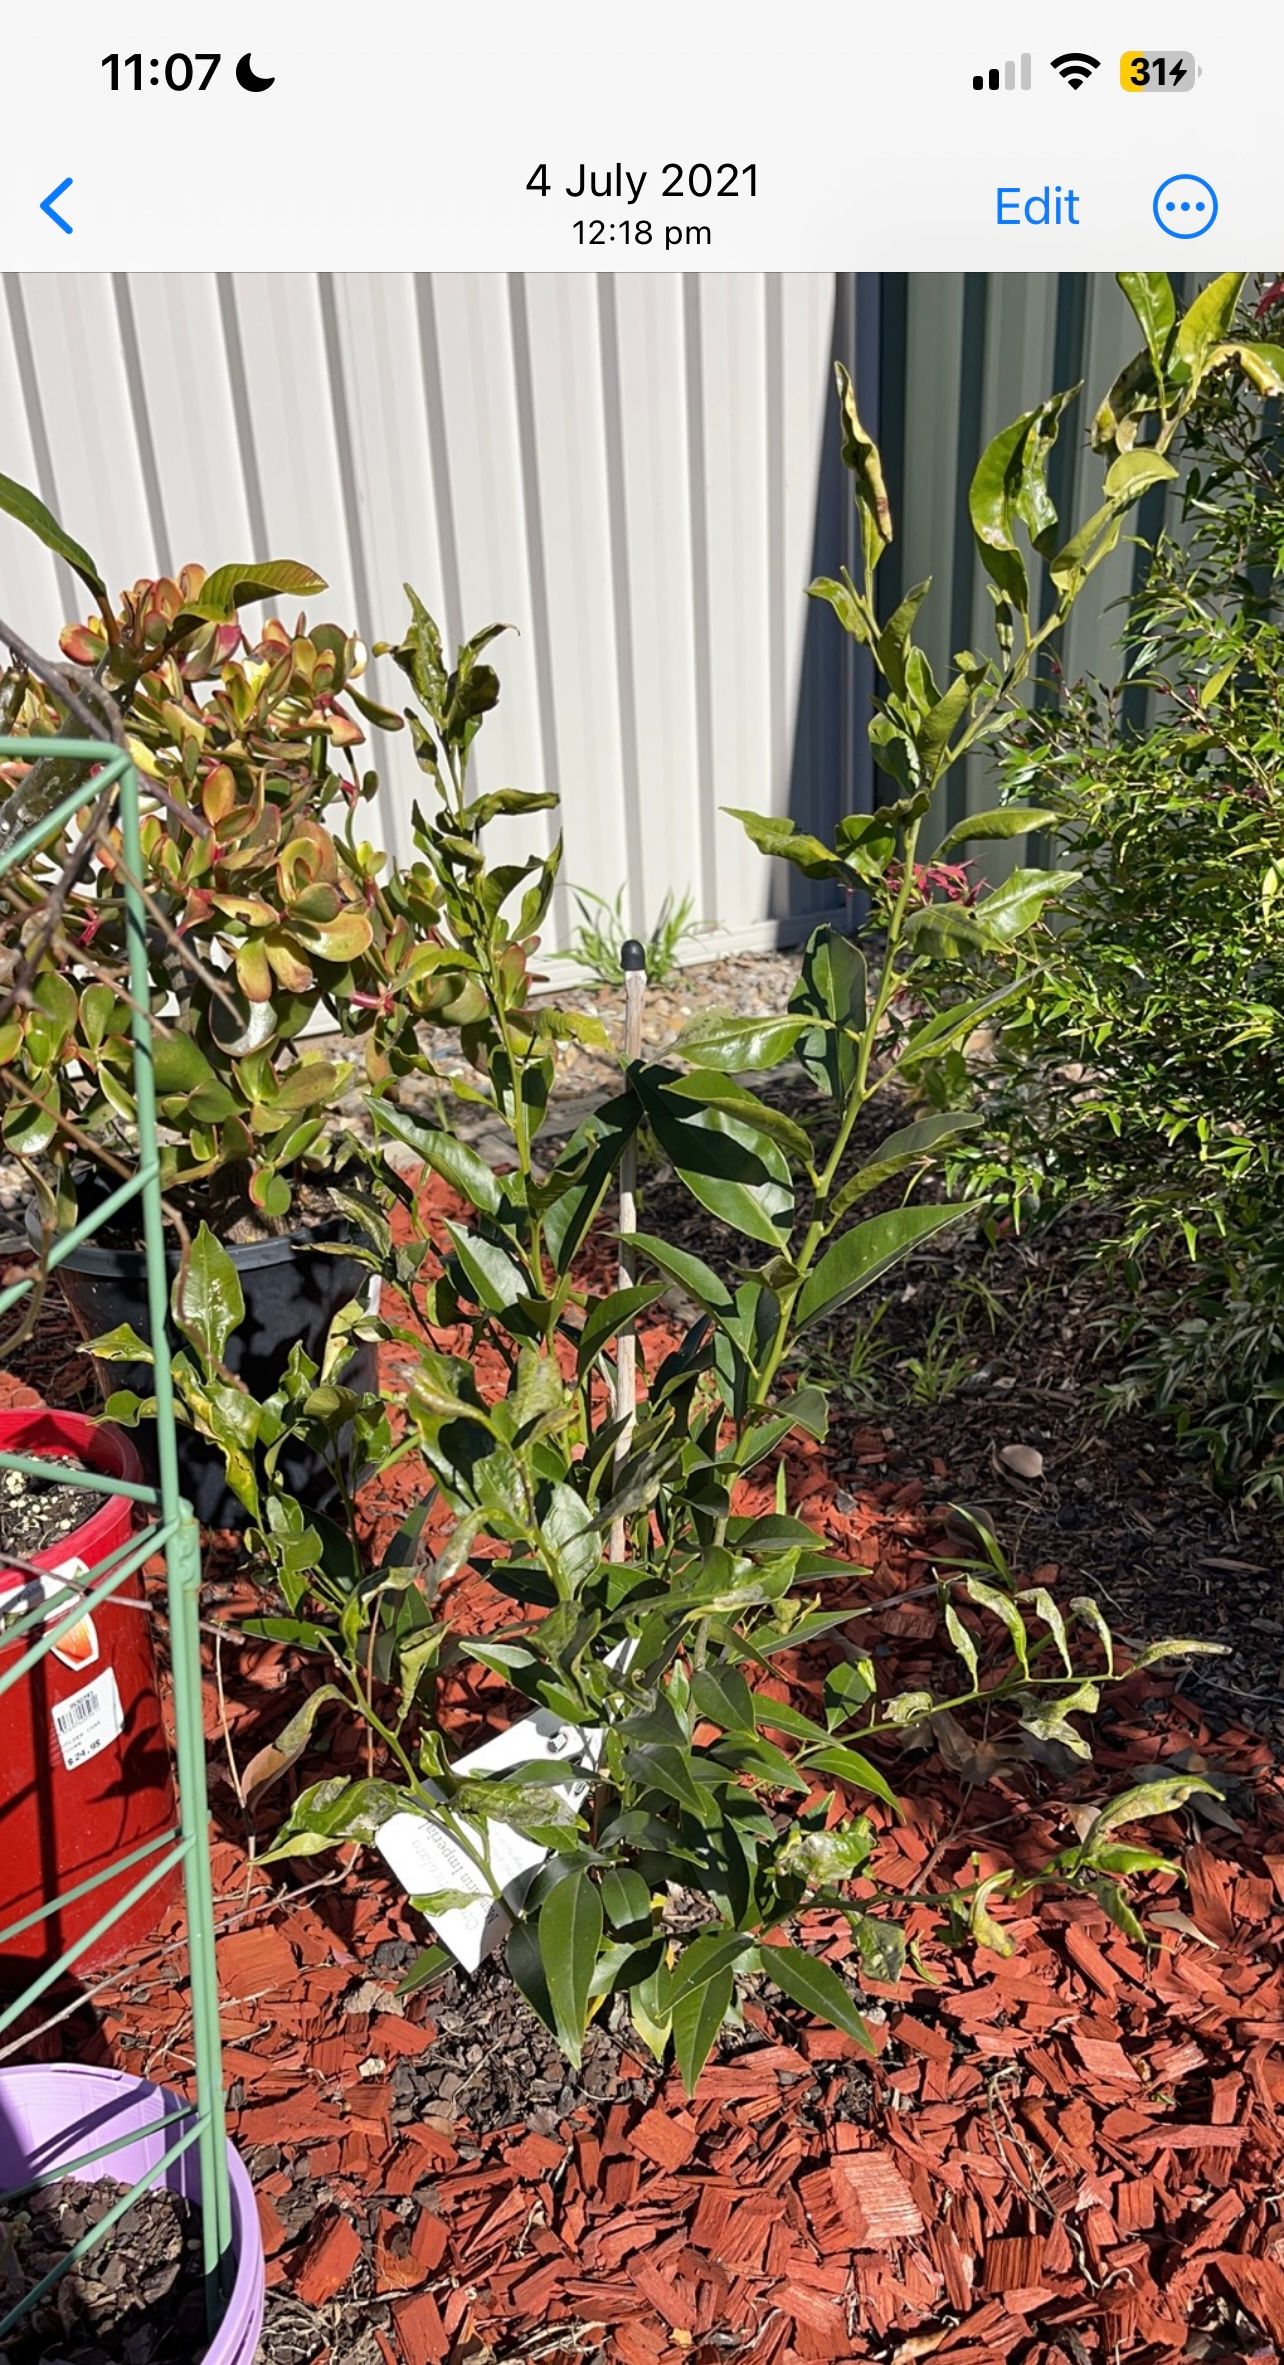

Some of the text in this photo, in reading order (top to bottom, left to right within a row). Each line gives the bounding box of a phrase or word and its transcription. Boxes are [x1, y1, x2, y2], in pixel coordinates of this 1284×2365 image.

[101, 52, 222, 92] 11:07
[1130, 57, 1166, 86] 31
[525, 161, 757, 206] 4 July 2021
[996, 185, 1080, 226] Edit
[572, 222, 712, 251] 12:18 pm
[417, 1820, 464, 1876] Imperial
